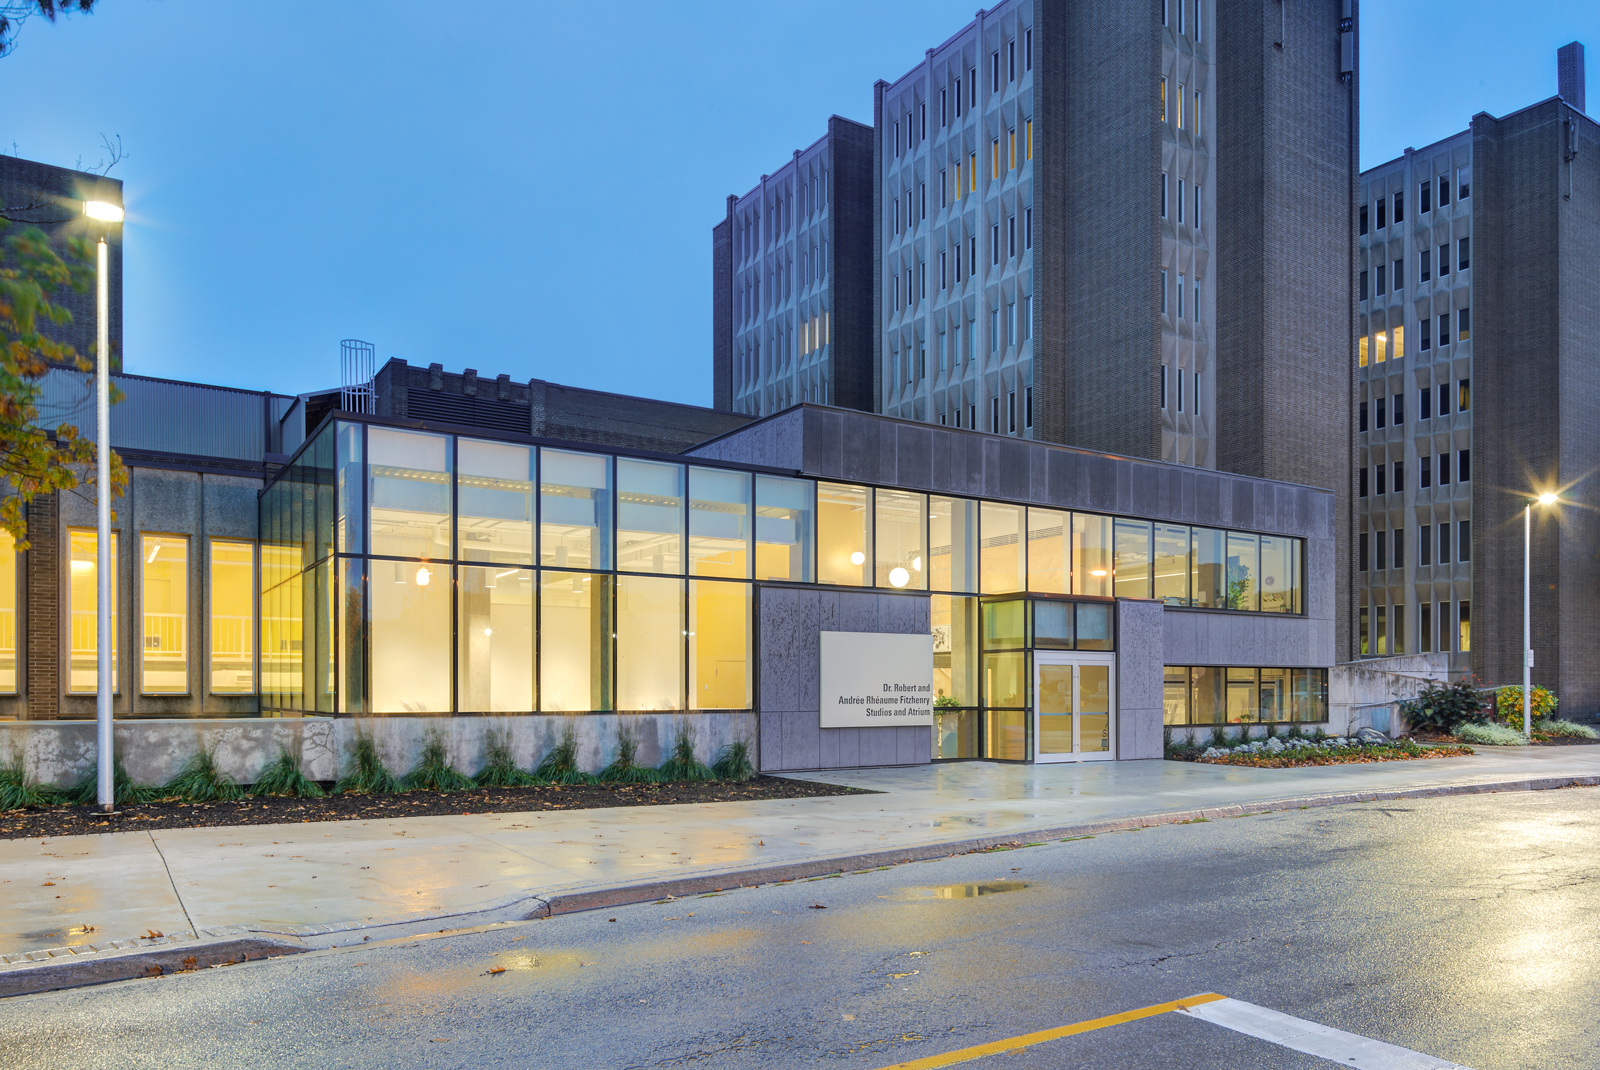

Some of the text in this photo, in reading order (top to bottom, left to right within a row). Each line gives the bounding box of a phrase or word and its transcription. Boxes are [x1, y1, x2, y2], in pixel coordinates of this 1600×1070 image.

[883, 684, 930, 692] Dr. Robert and
[838, 696, 930, 706] Andrée Rhéaume Fitzhenry
[866, 708, 930, 716] Studios and Atrium
